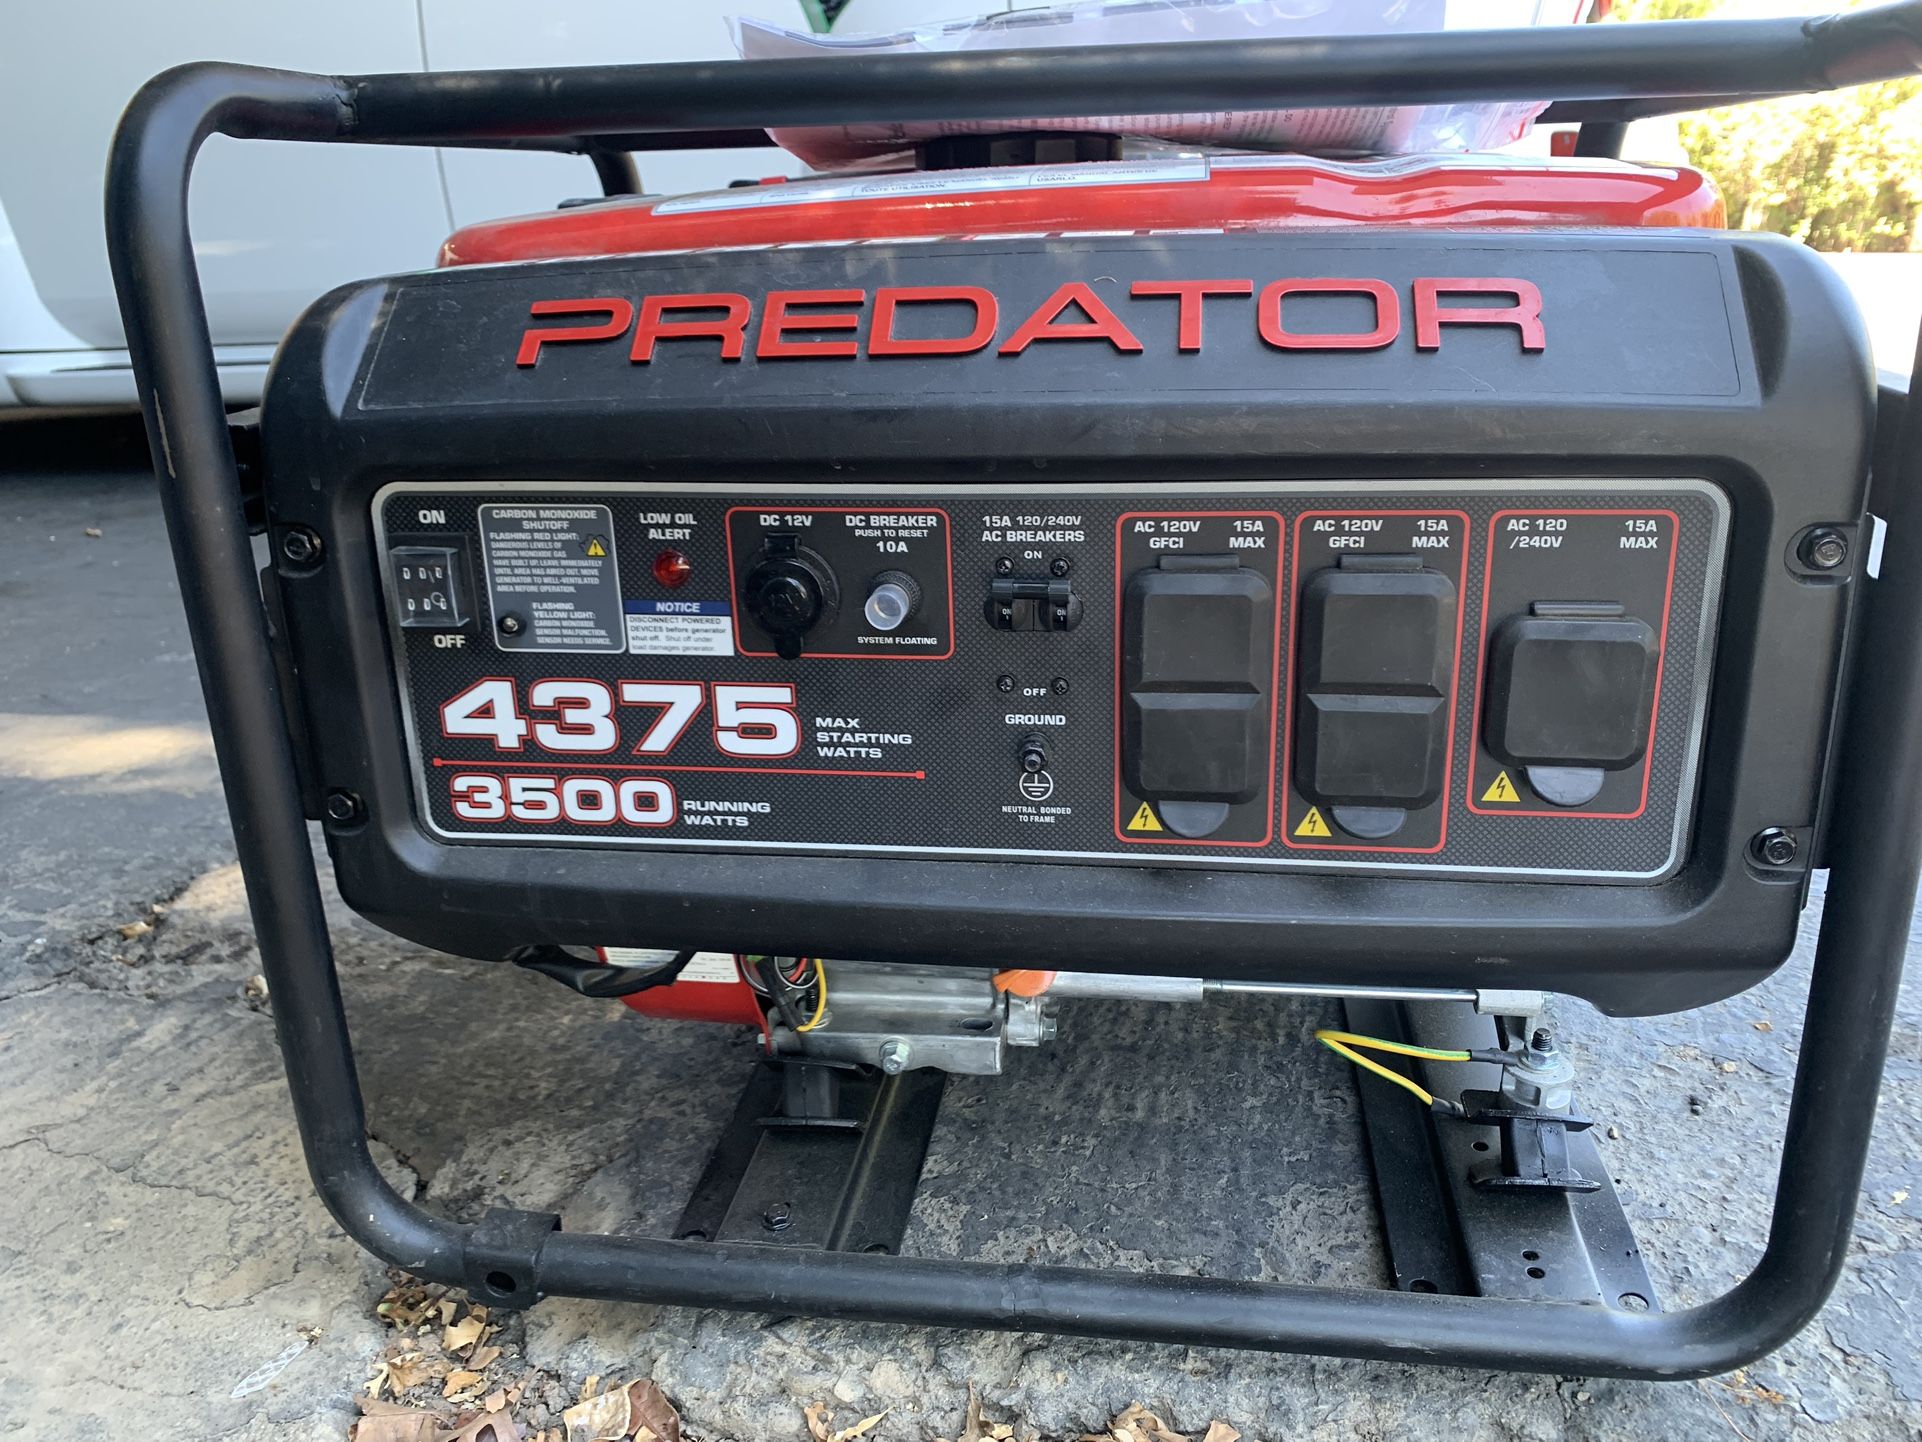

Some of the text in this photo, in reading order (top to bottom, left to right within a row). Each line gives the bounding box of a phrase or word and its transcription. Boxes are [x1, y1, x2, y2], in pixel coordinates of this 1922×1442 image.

[514, 277, 1546, 368] PREDATOR
[418, 509, 446, 524] ON
[492, 509, 597, 519] CARBON MONOXIDE
[639, 512, 697, 525] LOW OIL
[759, 514, 813, 526] DC 12V
[522, 520, 570, 530] SHUTOFF
[845, 515, 937, 527] DC BREAKER
[982, 515, 1082, 527] 15A 120/240V
[1133, 520, 1201, 533] AC 120V
[1232, 520, 1264, 532] 15A
[1312, 520, 1384, 532] AC 120V
[1416, 519, 1449, 532] 15A
[1506, 519, 1568, 531] AC 120
[1625, 520, 1657, 532] 15A
[489, 532, 532, 540] FLASHING
[533, 532, 551, 540] RED
[648, 528, 691, 540] ALERT
[854, 529, 929, 537] PUSH TO RESET
[981, 530, 1085, 542] AC BREAKERS
[491, 541, 529, 549] DANGEROUS
[875, 541, 908, 553] 10A
[1149, 537, 1184, 549] GFCI
[1228, 536, 1266, 549] MAX
[1328, 536, 1365, 548] GFCI
[1411, 536, 1450, 548] MAX
[1509, 536, 1563, 549] /240V
[1619, 536, 1659, 549] MAX
[1024, 550, 1042, 559] ON
[532, 602, 575, 610] FLASHING
[656, 602, 701, 612] NOTICE
[534, 619, 561, 627] CARBON
[629, 616, 721, 625] DISCONNECT POWERED
[630, 625, 664, 633] DEVICES
[433, 634, 466, 649] OFF
[857, 636, 937, 645] SYSTEM FLOATING
[648, 644, 680, 652] damages
[1023, 687, 1047, 696] OFF
[438, 676, 802, 760] 4375
[815, 716, 860, 729] MAX
[1005, 714, 1066, 726] GROUND
[816, 731, 913, 746] STARTING
[816, 746, 883, 759] WATTS
[449, 772, 677, 828] 3500
[683, 800, 771, 814] RUNNING
[1002, 805, 1072, 815] NEUTRAL BONDED
[683, 814, 749, 828] WATTS
[1030, 815, 1056, 823] FRAME
